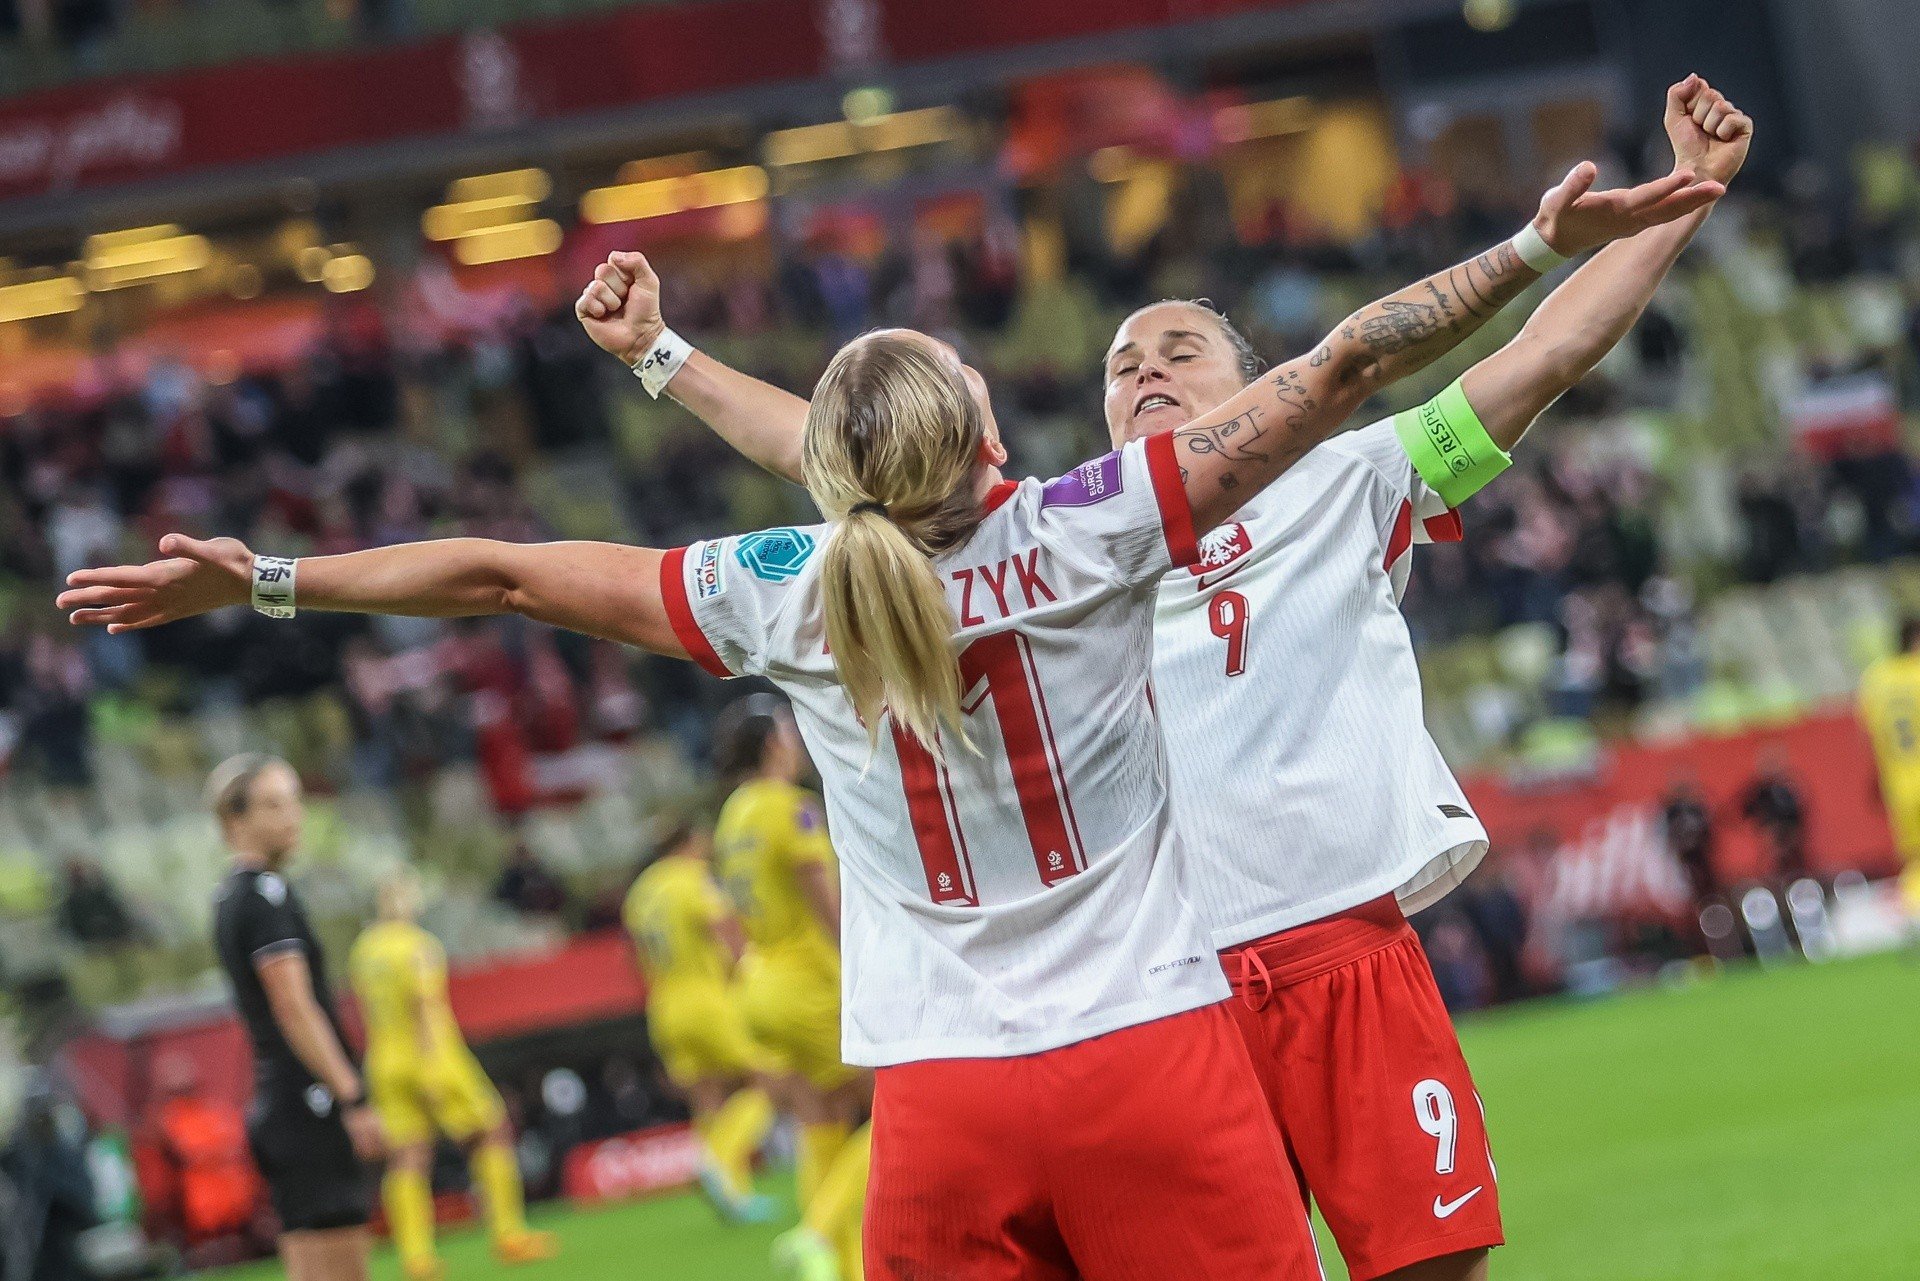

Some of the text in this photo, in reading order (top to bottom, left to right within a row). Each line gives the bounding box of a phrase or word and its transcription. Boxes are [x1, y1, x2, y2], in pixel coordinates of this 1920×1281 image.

[939, 547, 1058, 628] ZYK
[1208, 590, 1250, 678] 9
[859, 628, 1089, 907] 11
[1411, 1077, 1459, 1175] 9
